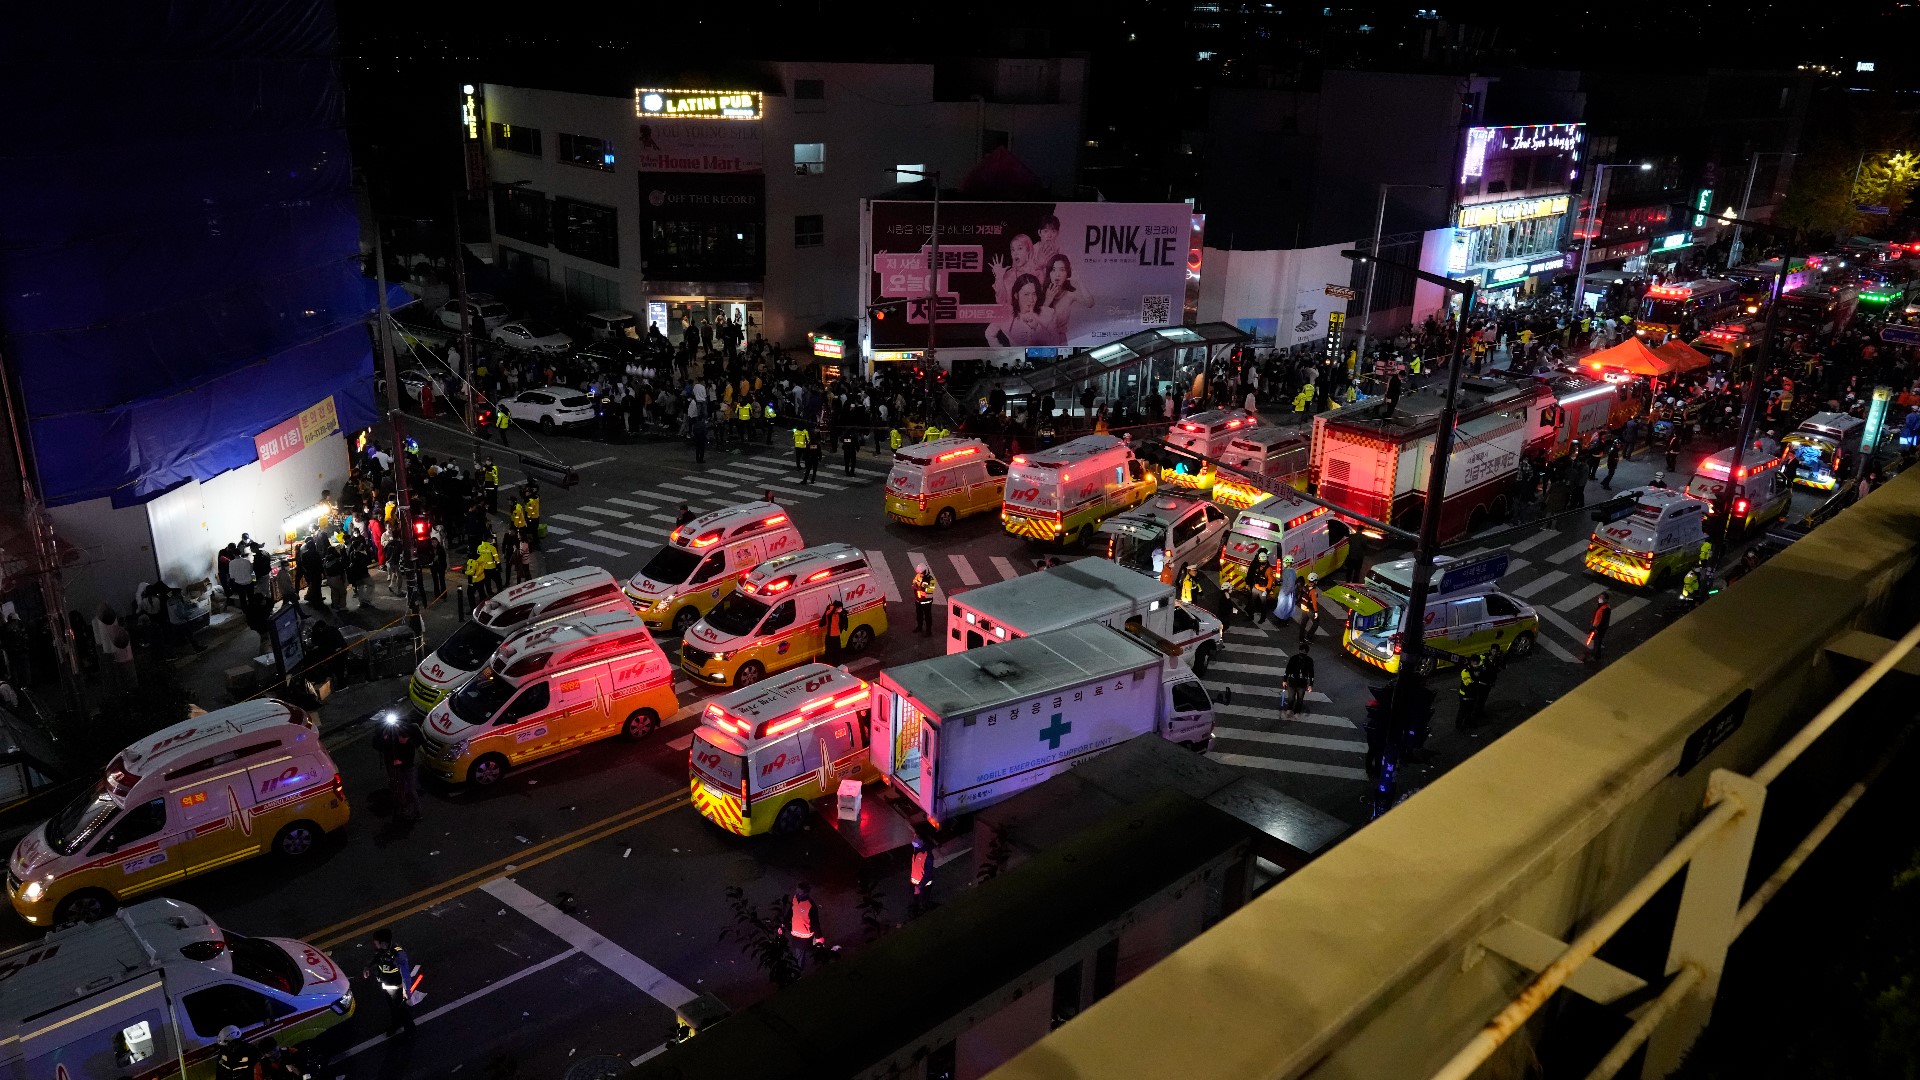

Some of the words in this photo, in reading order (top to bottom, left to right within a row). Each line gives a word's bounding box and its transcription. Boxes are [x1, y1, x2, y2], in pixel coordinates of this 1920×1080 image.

[667, 97, 716, 113] LATIN
[719, 95, 753, 109] PUB
[658, 154, 701, 169] Home
[702, 155, 742, 170] Mart
[668, 194, 687, 204] OFF
[689, 194, 711, 204] THE
[713, 195, 756, 205] RECORD
[887, 225, 913, 235] 사랑을
[976, 225, 1002, 236] 거짓말
[1085, 225, 1140, 254] PINK
[1145, 225, 1178, 236] 핑크라이
[1139, 237, 1177, 266] LIE
[887, 258, 897, 269] 저
[889, 274, 942, 292] 오늘이
[260, 438, 279, 461] 임대
[1010, 488, 1039, 502] 119
[1607, 528, 1633, 539] 119
[769, 535, 787, 551] 119
[846, 583, 866, 602] 119
[619, 661, 646, 683] 119
[697, 751, 721, 769] 119
[761, 753, 787, 777] 119
[977, 769, 1008, 783] MOBILE
[1009, 755, 1056, 774] EMERGENCY
[1059, 742, 1093, 760] SUPPORT
[1095, 736, 1113, 749] UNIT
